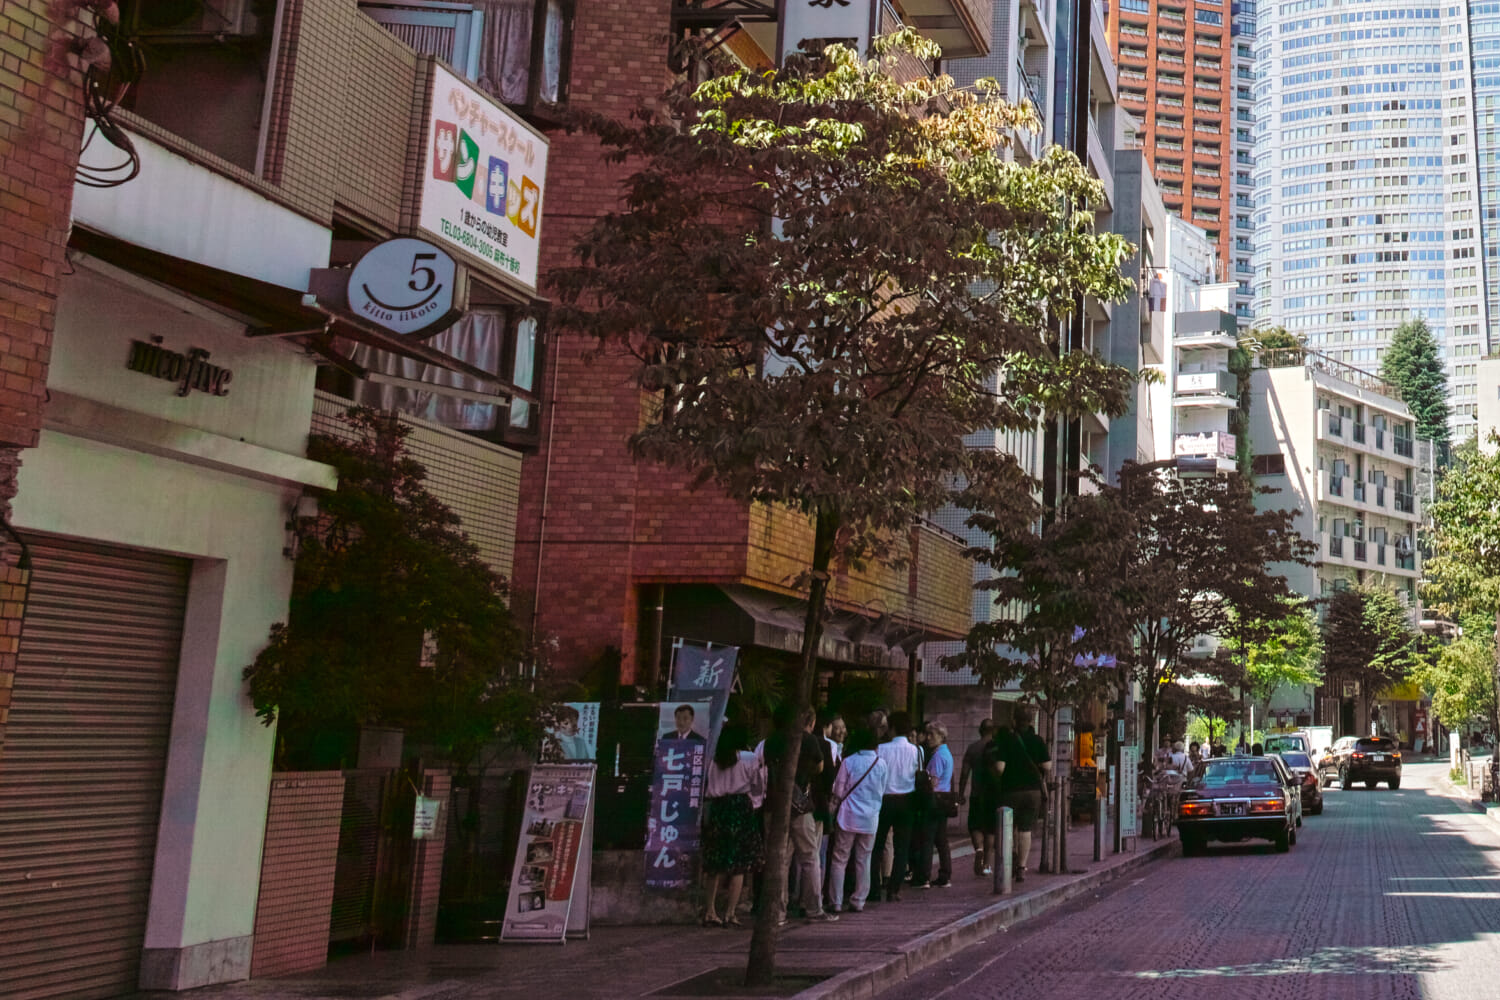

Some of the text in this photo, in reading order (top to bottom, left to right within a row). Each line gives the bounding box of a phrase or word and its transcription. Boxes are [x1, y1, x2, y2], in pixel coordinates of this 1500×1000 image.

[448, 87, 535, 167] ベンチャースクール
[407, 253, 437, 292] 5
[363, 301, 438, 321] kitto iikoto
[653, 748, 685, 868] 七戸じゅん
